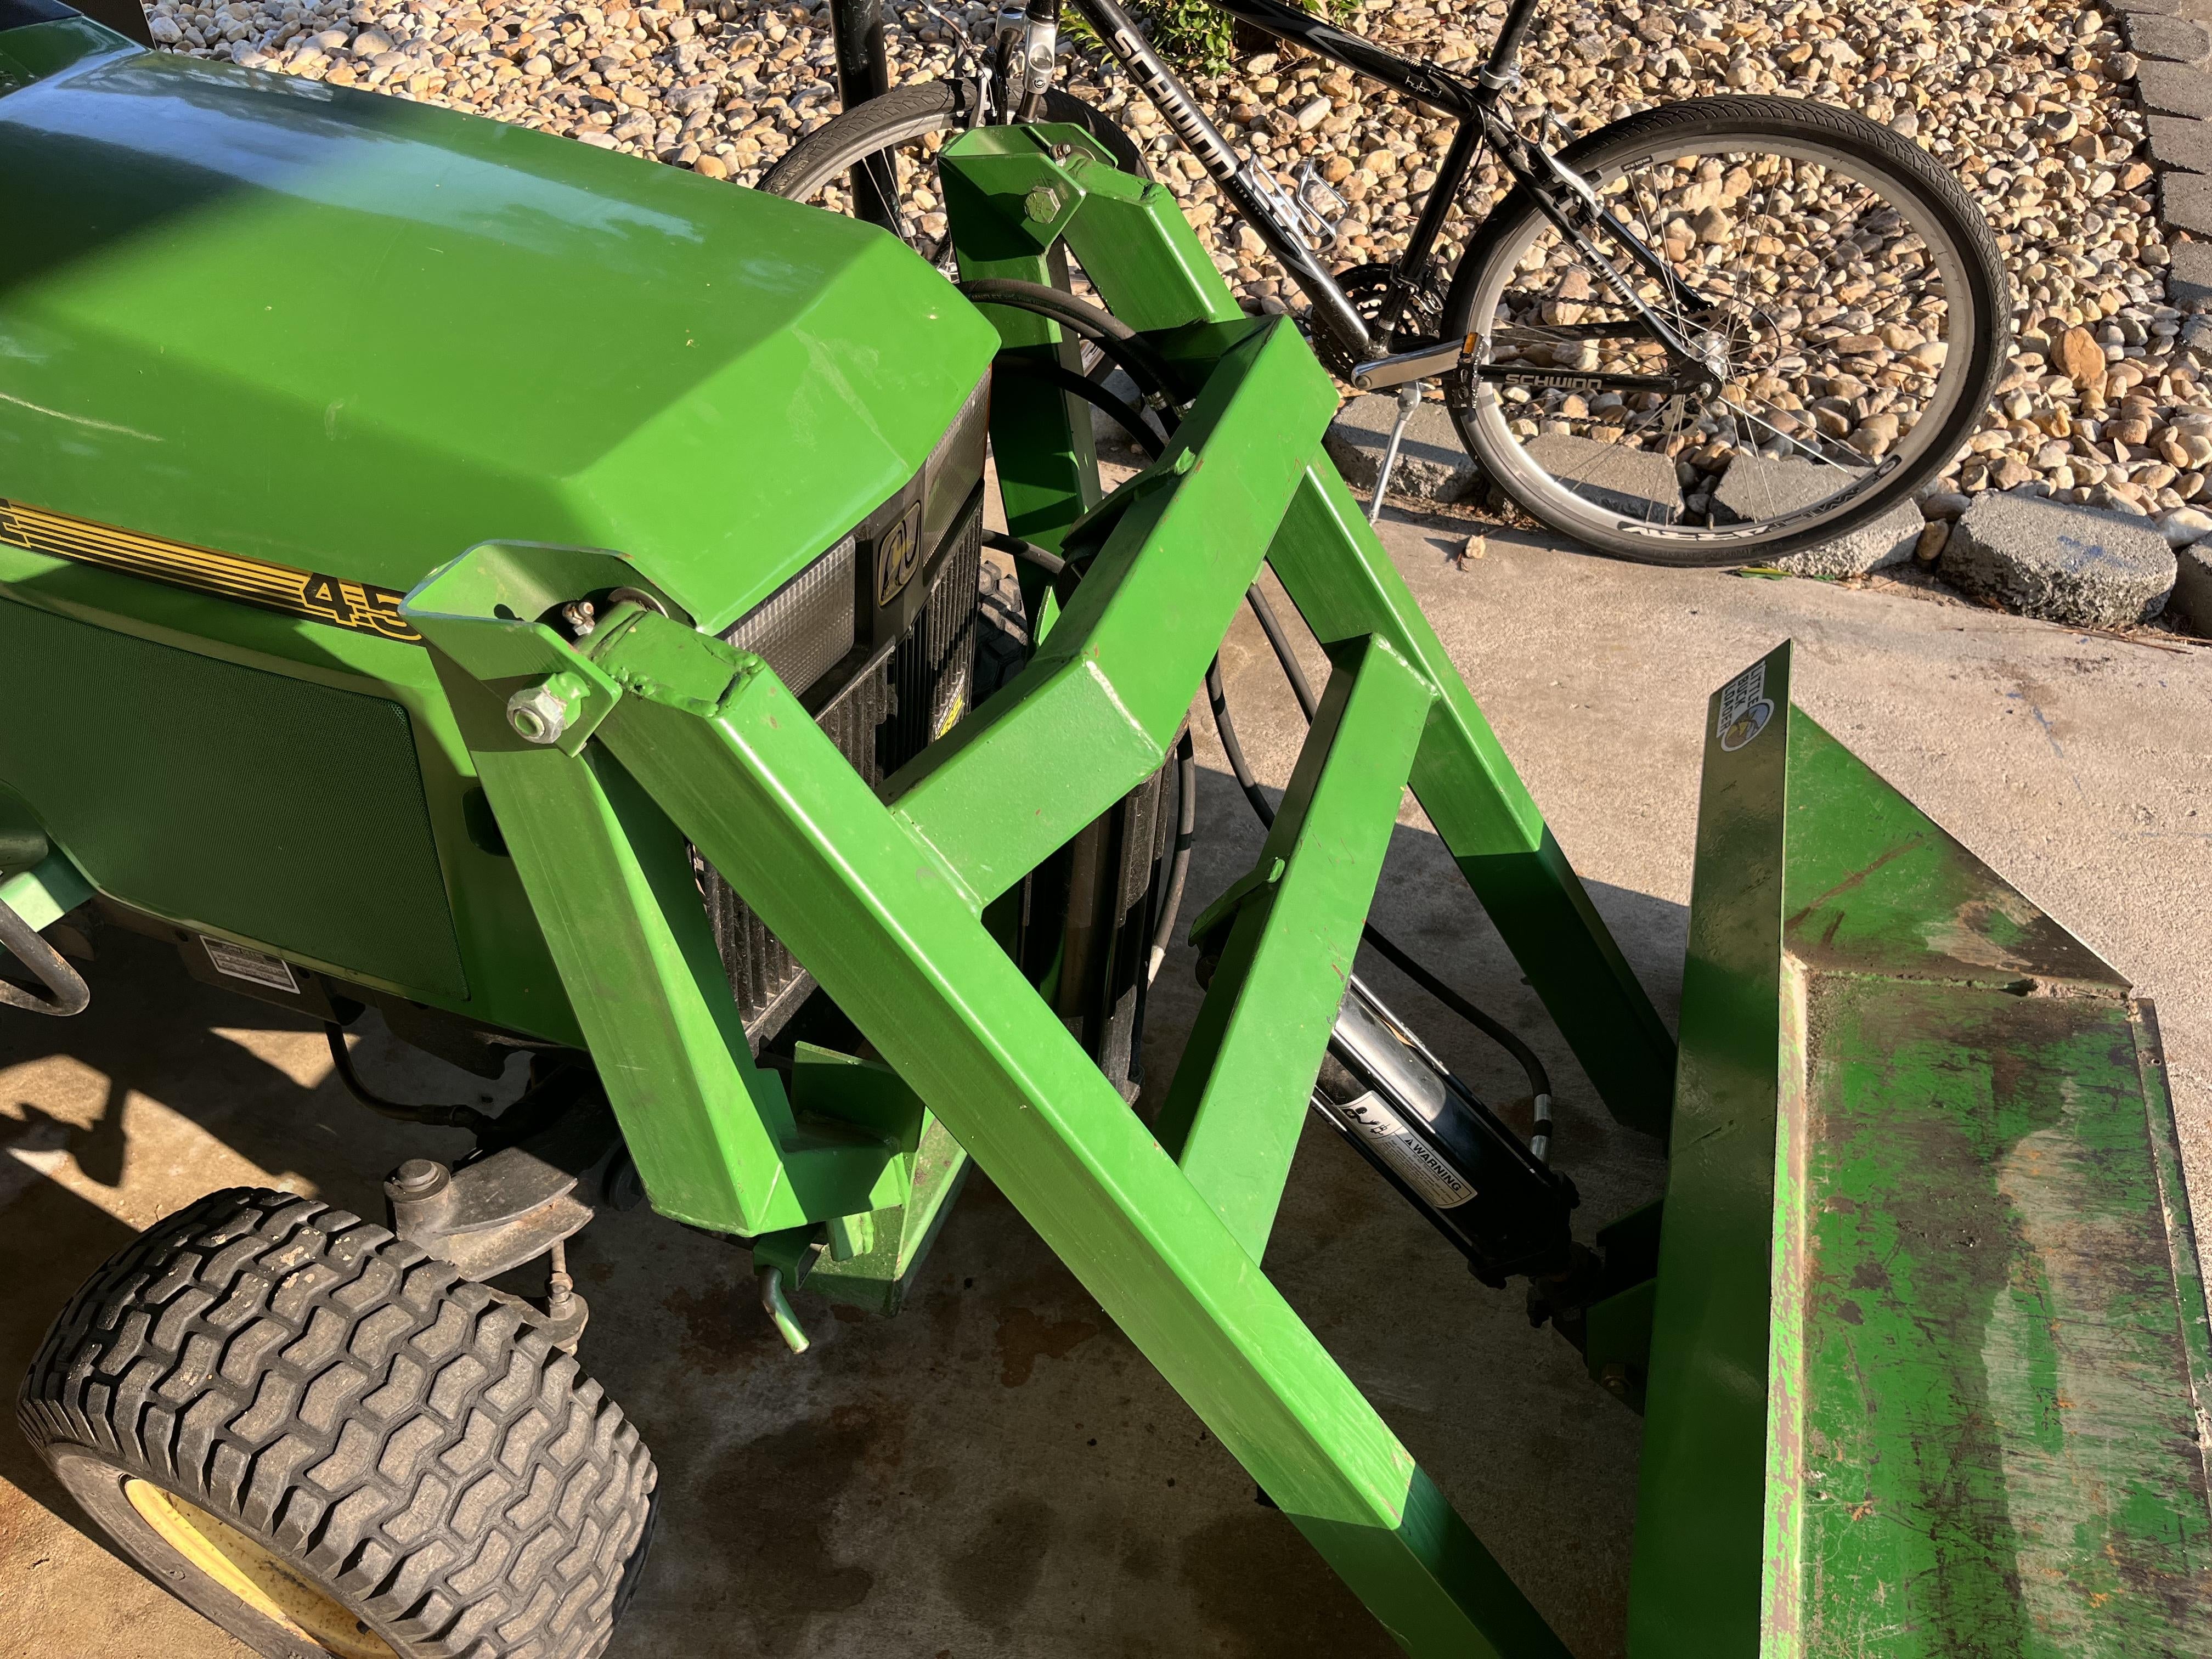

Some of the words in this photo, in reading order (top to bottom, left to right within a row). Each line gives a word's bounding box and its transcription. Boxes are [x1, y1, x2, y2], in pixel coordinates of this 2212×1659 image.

[1107, 29, 1236, 181] SCHWINN
[1406, 76, 1442, 98] hybrid
[1575, 239, 1645, 316] SCHWINN
[1505, 374, 1602, 390] SCHWINN
[1720, 684, 1736, 733] LOADER
[1734, 674, 1749, 710] BUCK
[1747, 664, 1763, 708] LITTLE
[1413, 1143, 1462, 1192] WARNING
